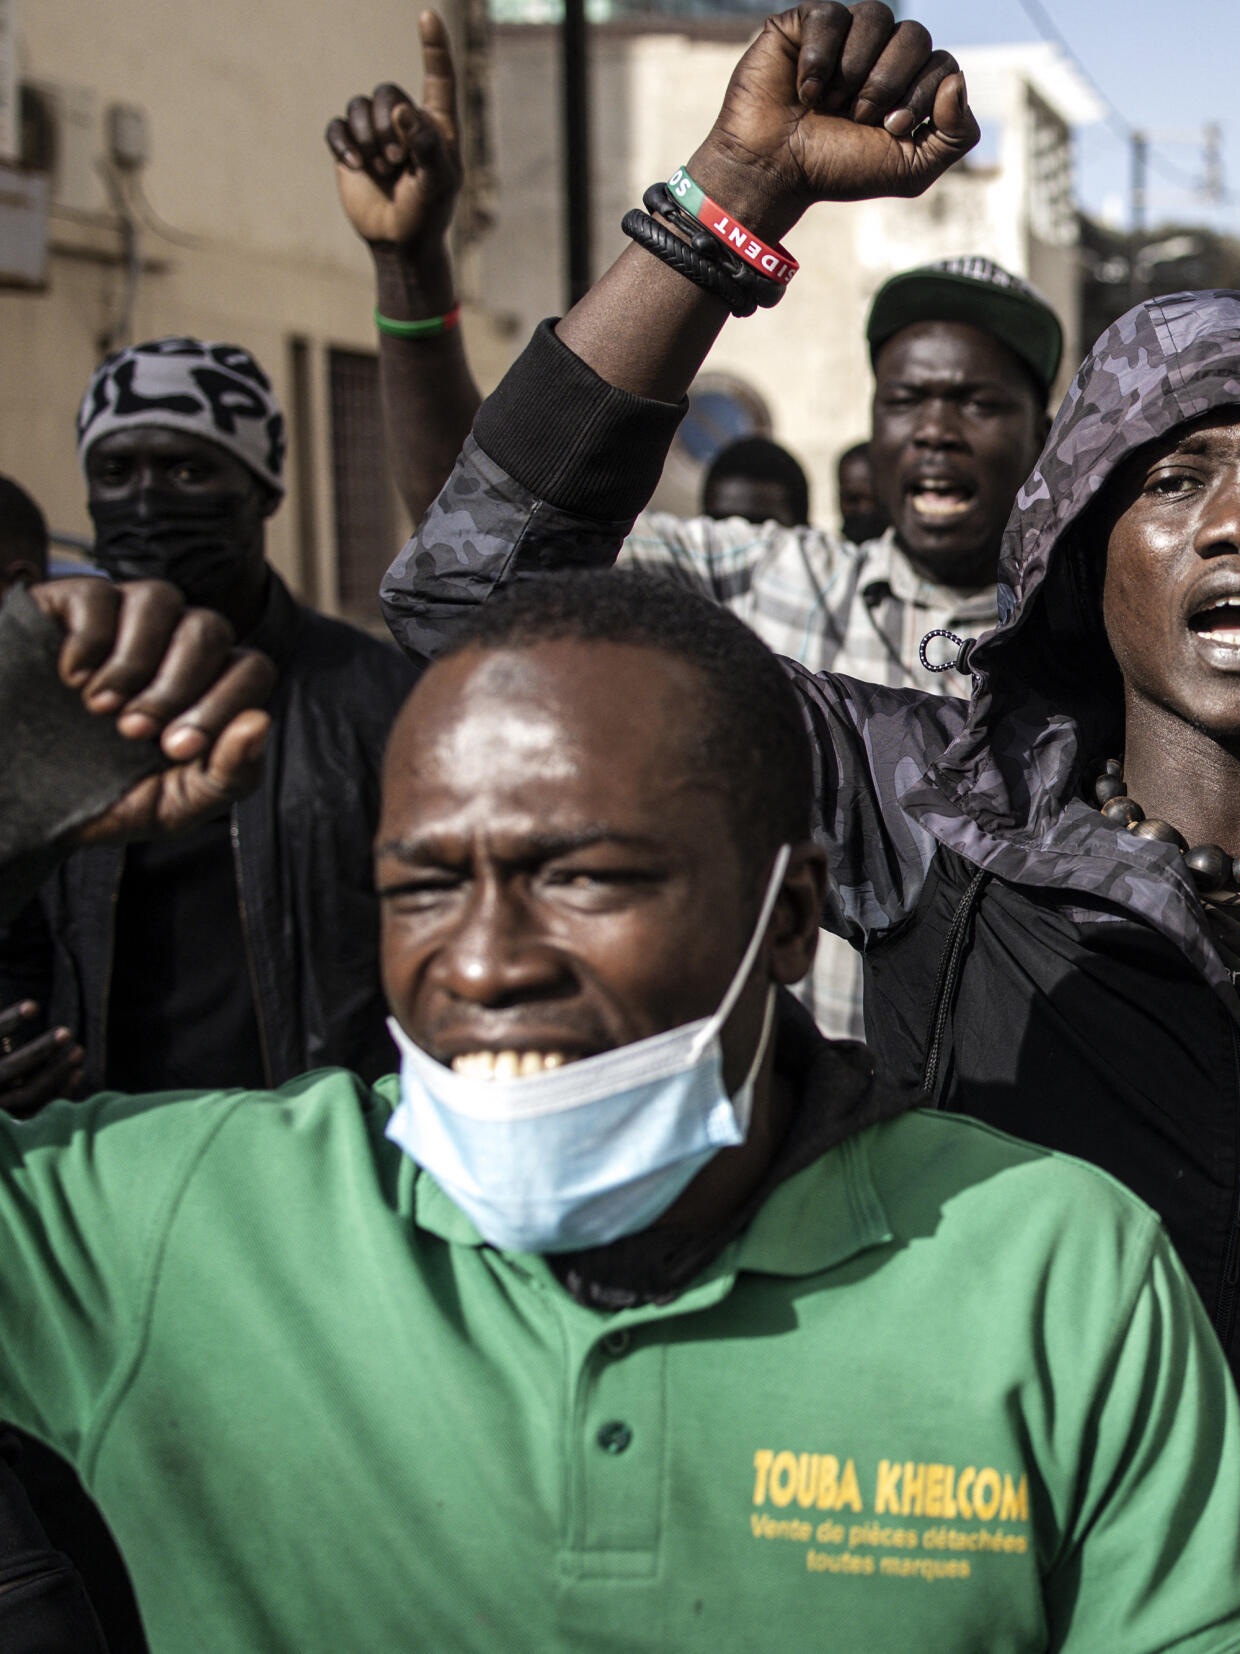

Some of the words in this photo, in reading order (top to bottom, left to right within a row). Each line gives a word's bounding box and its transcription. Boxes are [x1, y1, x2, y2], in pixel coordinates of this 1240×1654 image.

[668, 169, 692, 198] SO
[753, 1449, 864, 1513] TOUBA
[874, 1459, 1030, 1522] KHELCOM
[751, 1513, 813, 1542] Vente
[816, 1518, 845, 1544] de
[849, 1520, 919, 1549] pièces
[922, 1524, 1029, 1554] détachées
[806, 1548, 876, 1576] toutes
[879, 1556, 971, 1582] marques
